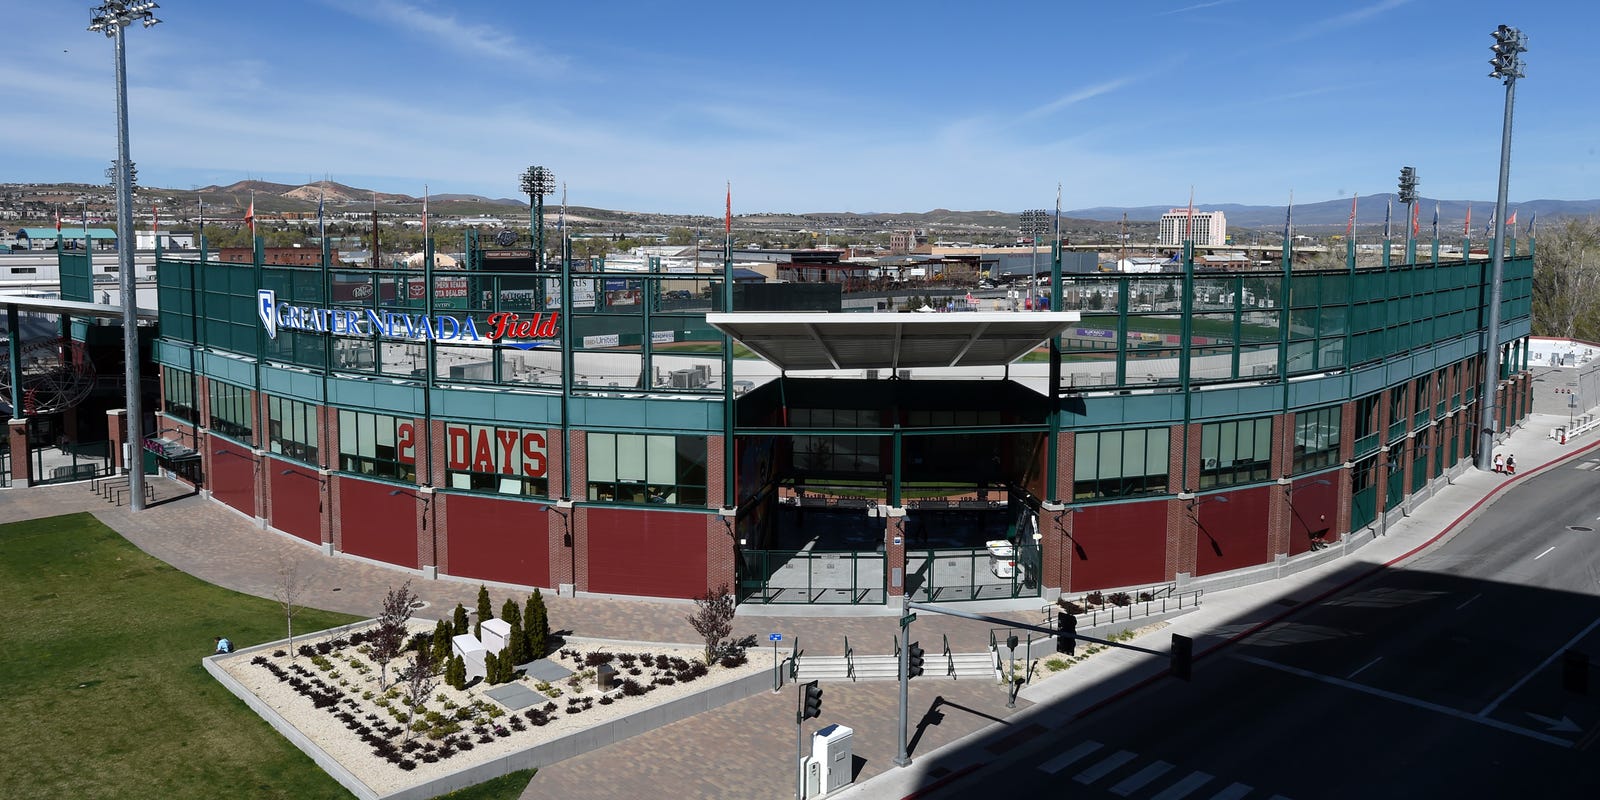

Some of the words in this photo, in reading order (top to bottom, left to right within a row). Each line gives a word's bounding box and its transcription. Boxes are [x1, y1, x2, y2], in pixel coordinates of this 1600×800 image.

[275, 302, 362, 335] GREATER
[364, 308, 482, 342] NEVADA
[485, 311, 560, 341] Field
[397, 423, 415, 464] 2
[448, 426, 547, 478] DAYS
